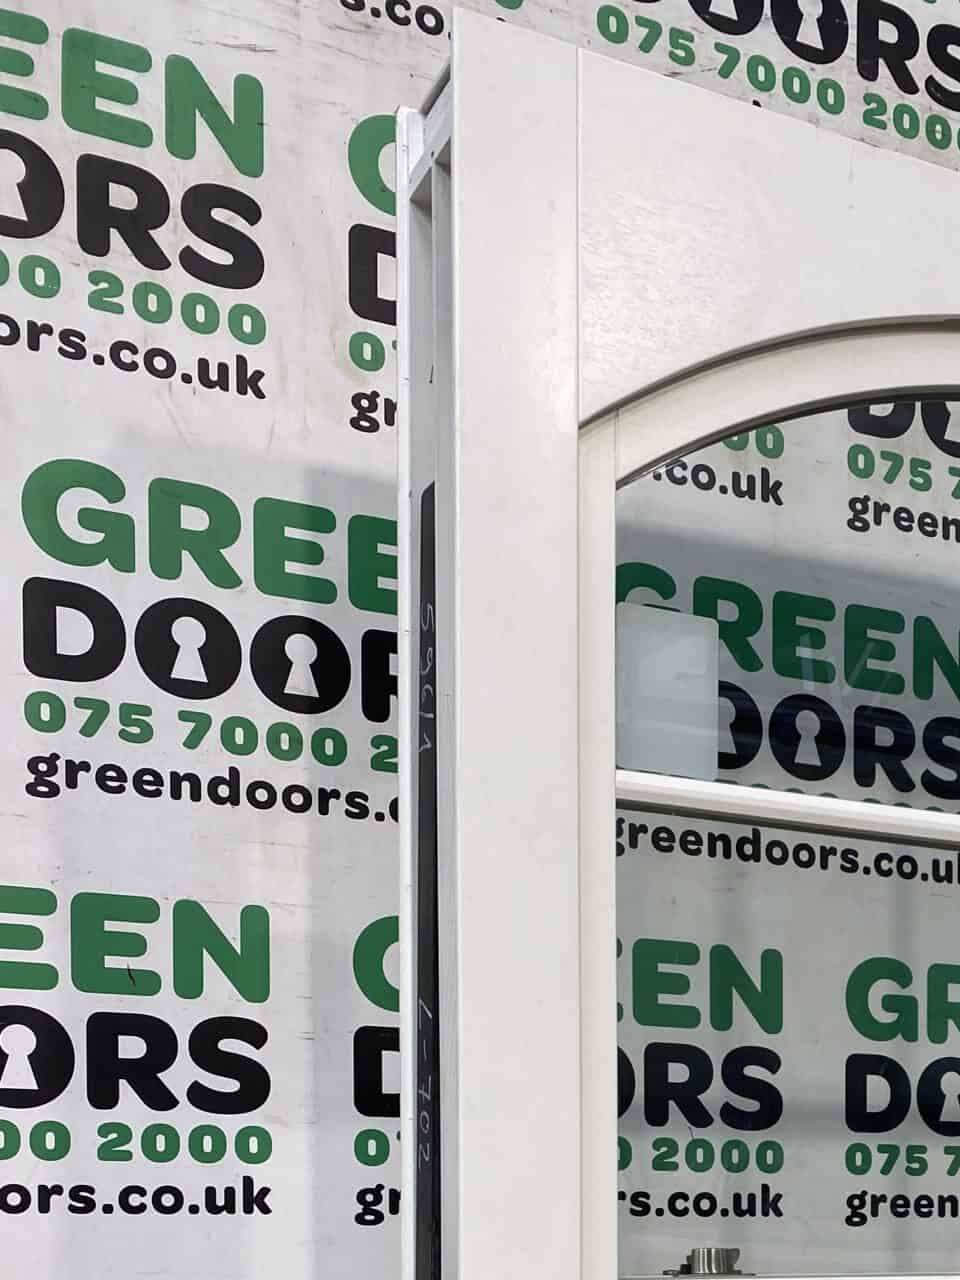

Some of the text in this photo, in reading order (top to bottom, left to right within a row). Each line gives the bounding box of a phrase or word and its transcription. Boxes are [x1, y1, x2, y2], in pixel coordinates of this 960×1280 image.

[597, 5, 695, 66] 075
[713, 42, 845, 115] 7000
[87, 269, 267, 345] 2000
[848, 444, 932, 491] 075
[24, 690, 154, 744] 075
[178, 710, 348, 766] 7000
[25, 752, 397, 823] greendoors.
[97, 1122, 272, 1165] 2000
[652, 1137, 784, 1174] 2000
[845, 1142, 929, 1178] 075
